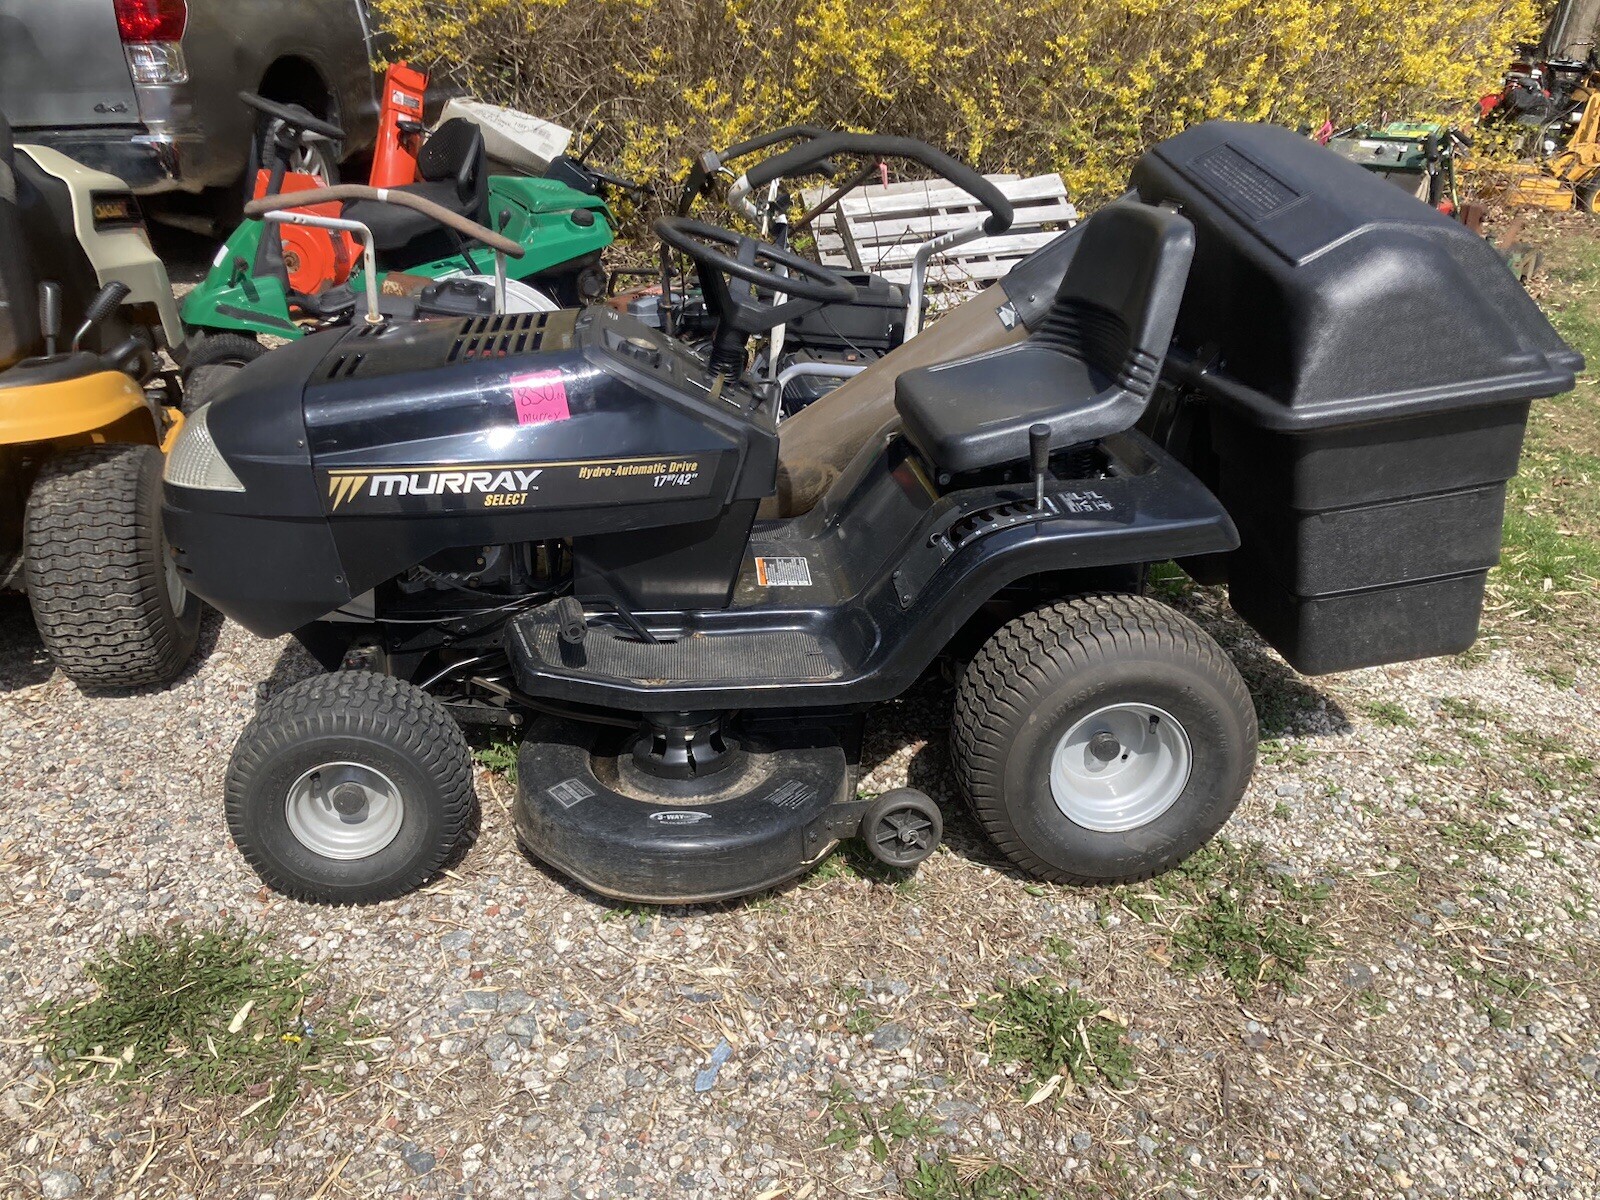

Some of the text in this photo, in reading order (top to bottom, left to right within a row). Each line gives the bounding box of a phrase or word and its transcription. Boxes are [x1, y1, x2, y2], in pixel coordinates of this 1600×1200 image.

[578, 461, 698, 480] Hydro-Automatic Drive
[369, 469, 543, 496] MURRAY
[484, 493, 528, 507] SELECT
